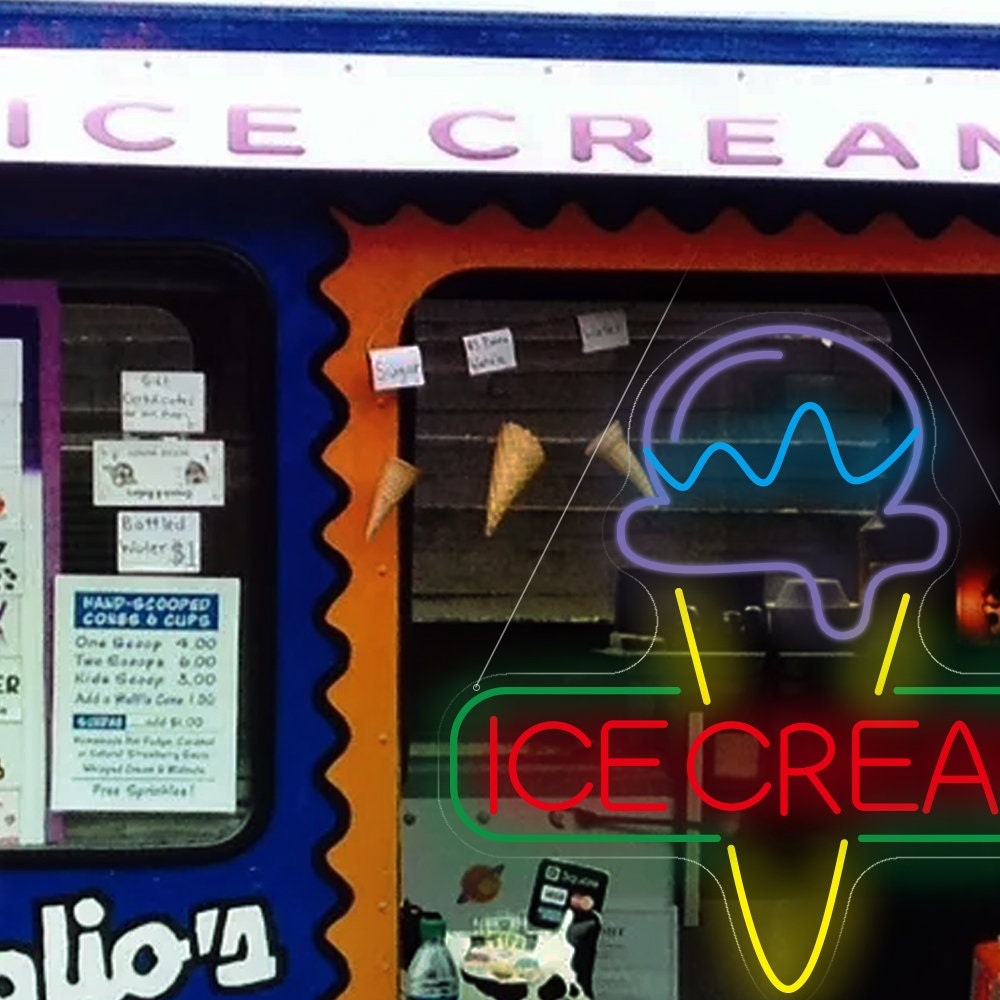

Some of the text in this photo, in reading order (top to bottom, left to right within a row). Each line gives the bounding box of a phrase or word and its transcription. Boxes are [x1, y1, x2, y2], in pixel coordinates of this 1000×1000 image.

[8, 98, 305, 156] ICE
[82, 612, 140, 627] CONES
[164, 613, 211, 628] CUPS
[75, 636, 106, 648] One
[112, 637, 162, 652] Scoop
[75, 654, 102, 667] Two
[107, 654, 164, 670] Scoops
[115, 672, 164, 689] Scoop
